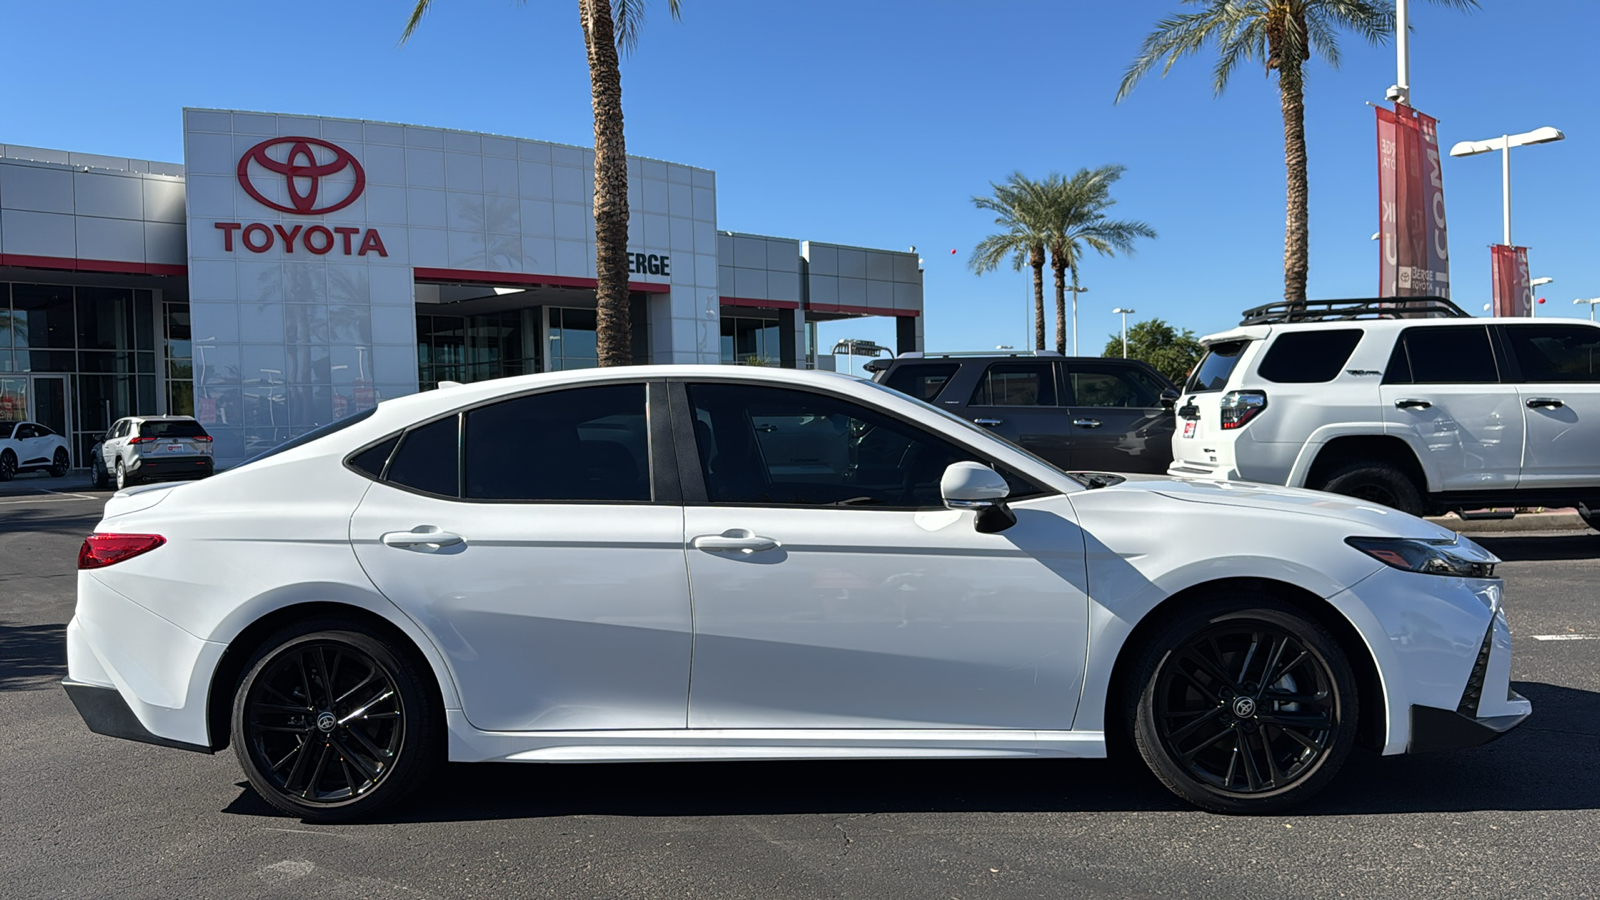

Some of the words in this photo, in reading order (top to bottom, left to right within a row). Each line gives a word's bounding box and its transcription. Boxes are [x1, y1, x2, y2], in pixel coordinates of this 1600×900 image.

[214, 222, 389, 258] TOYOTA
[626, 252, 671, 277] ERGE
[1411, 280, 1434, 292] TOYOTA
